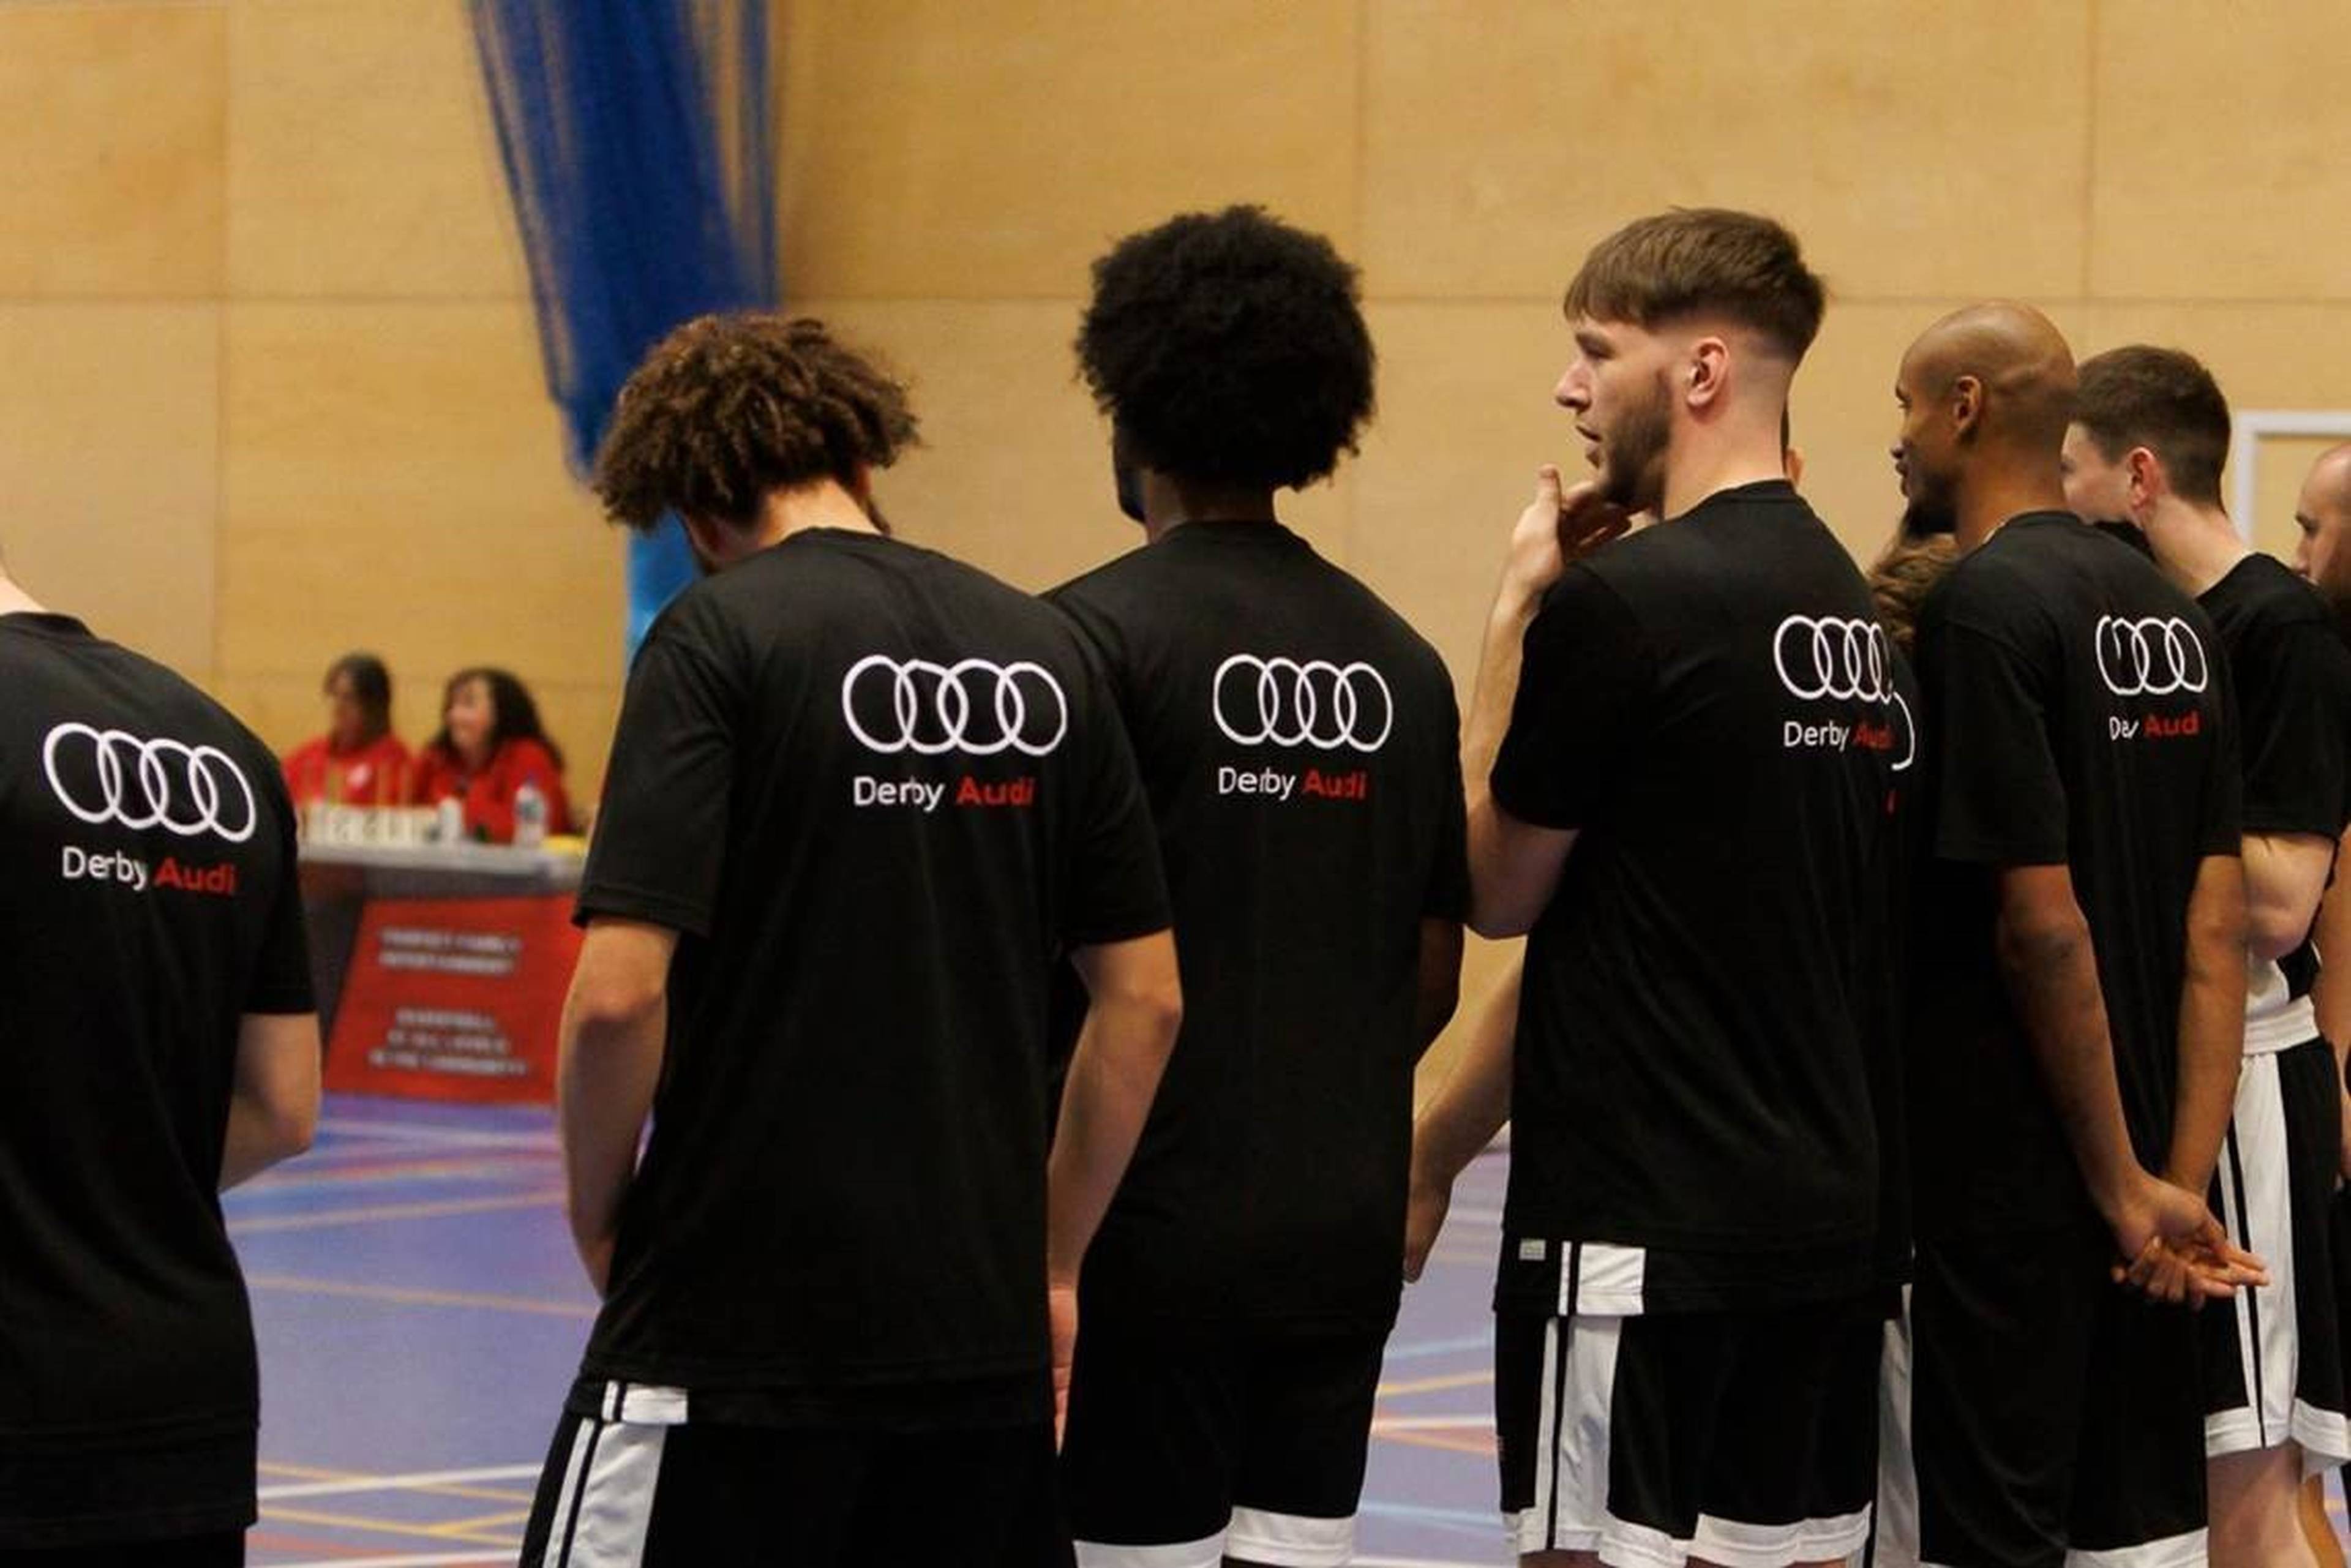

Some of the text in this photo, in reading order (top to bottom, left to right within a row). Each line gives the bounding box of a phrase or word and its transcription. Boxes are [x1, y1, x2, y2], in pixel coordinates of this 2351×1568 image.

[1784, 720, 1850, 752] Derby
[2143, 711, 2202, 737] Aud
[853, 775, 1035, 813] Derby Audi
[1218, 767, 1368, 801] Derby Audi
[62, 846, 237, 895] Derby Audi
